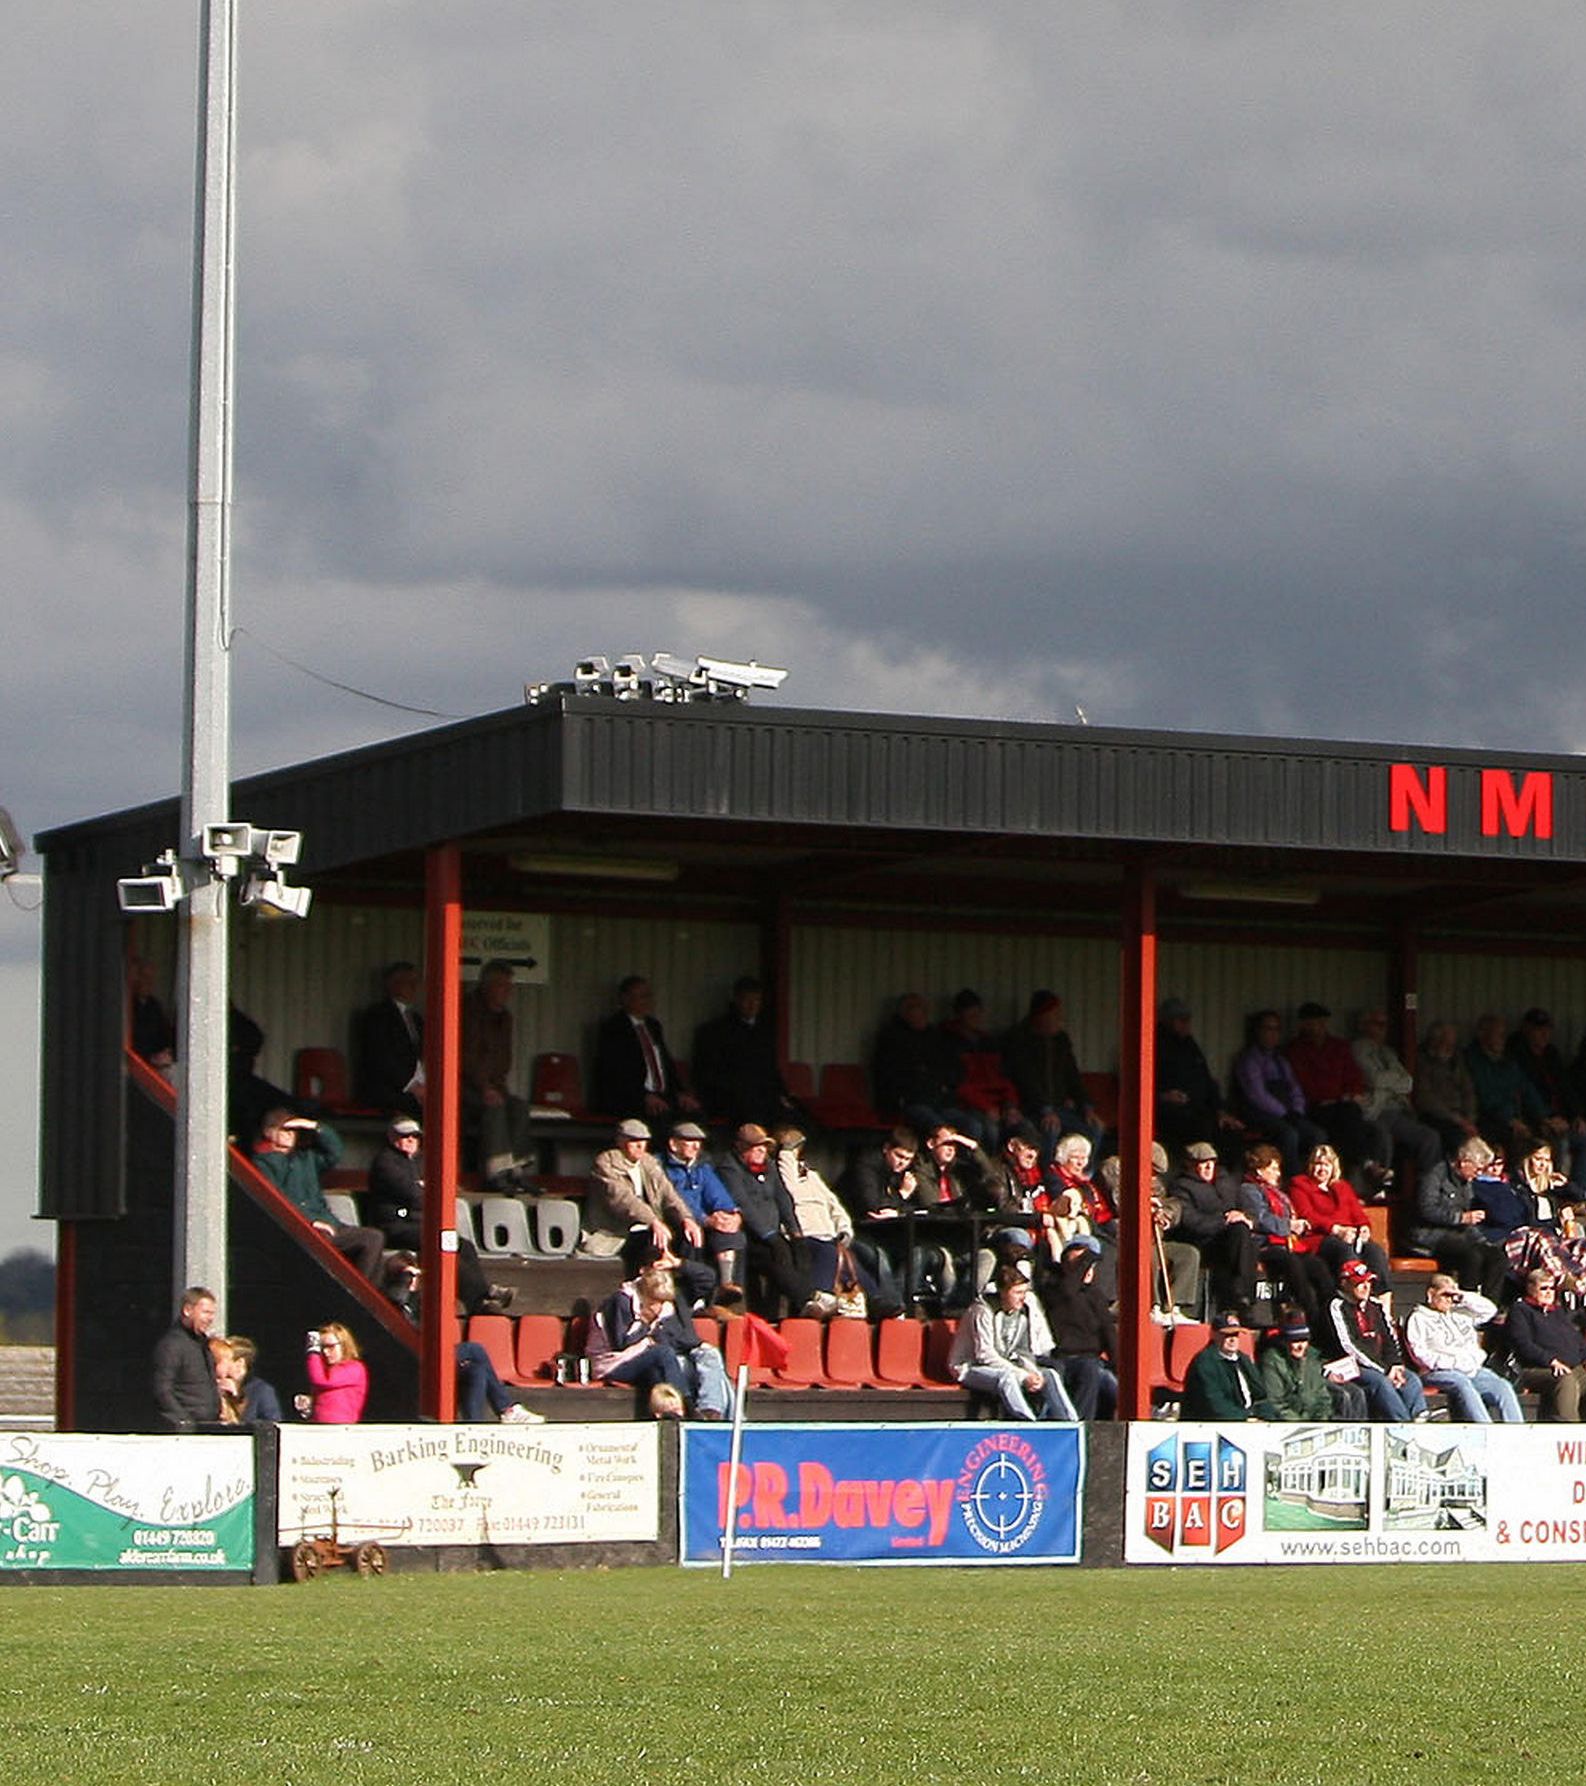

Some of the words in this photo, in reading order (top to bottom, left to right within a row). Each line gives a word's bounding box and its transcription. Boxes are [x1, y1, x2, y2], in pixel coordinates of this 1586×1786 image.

[370, 1438, 449, 1473] Barking
[455, 1432, 564, 1474] Engineering
[956, 1433, 1049, 1501] ENGINEERING
[1150, 1458, 1243, 1490] SEH
[961, 1502, 999, 1552] PRECISION
[1150, 1499, 1243, 1531] BAC
[1280, 1537, 1461, 1557] www.sehbac.com
[1496, 1521, 1511, 1544] &
